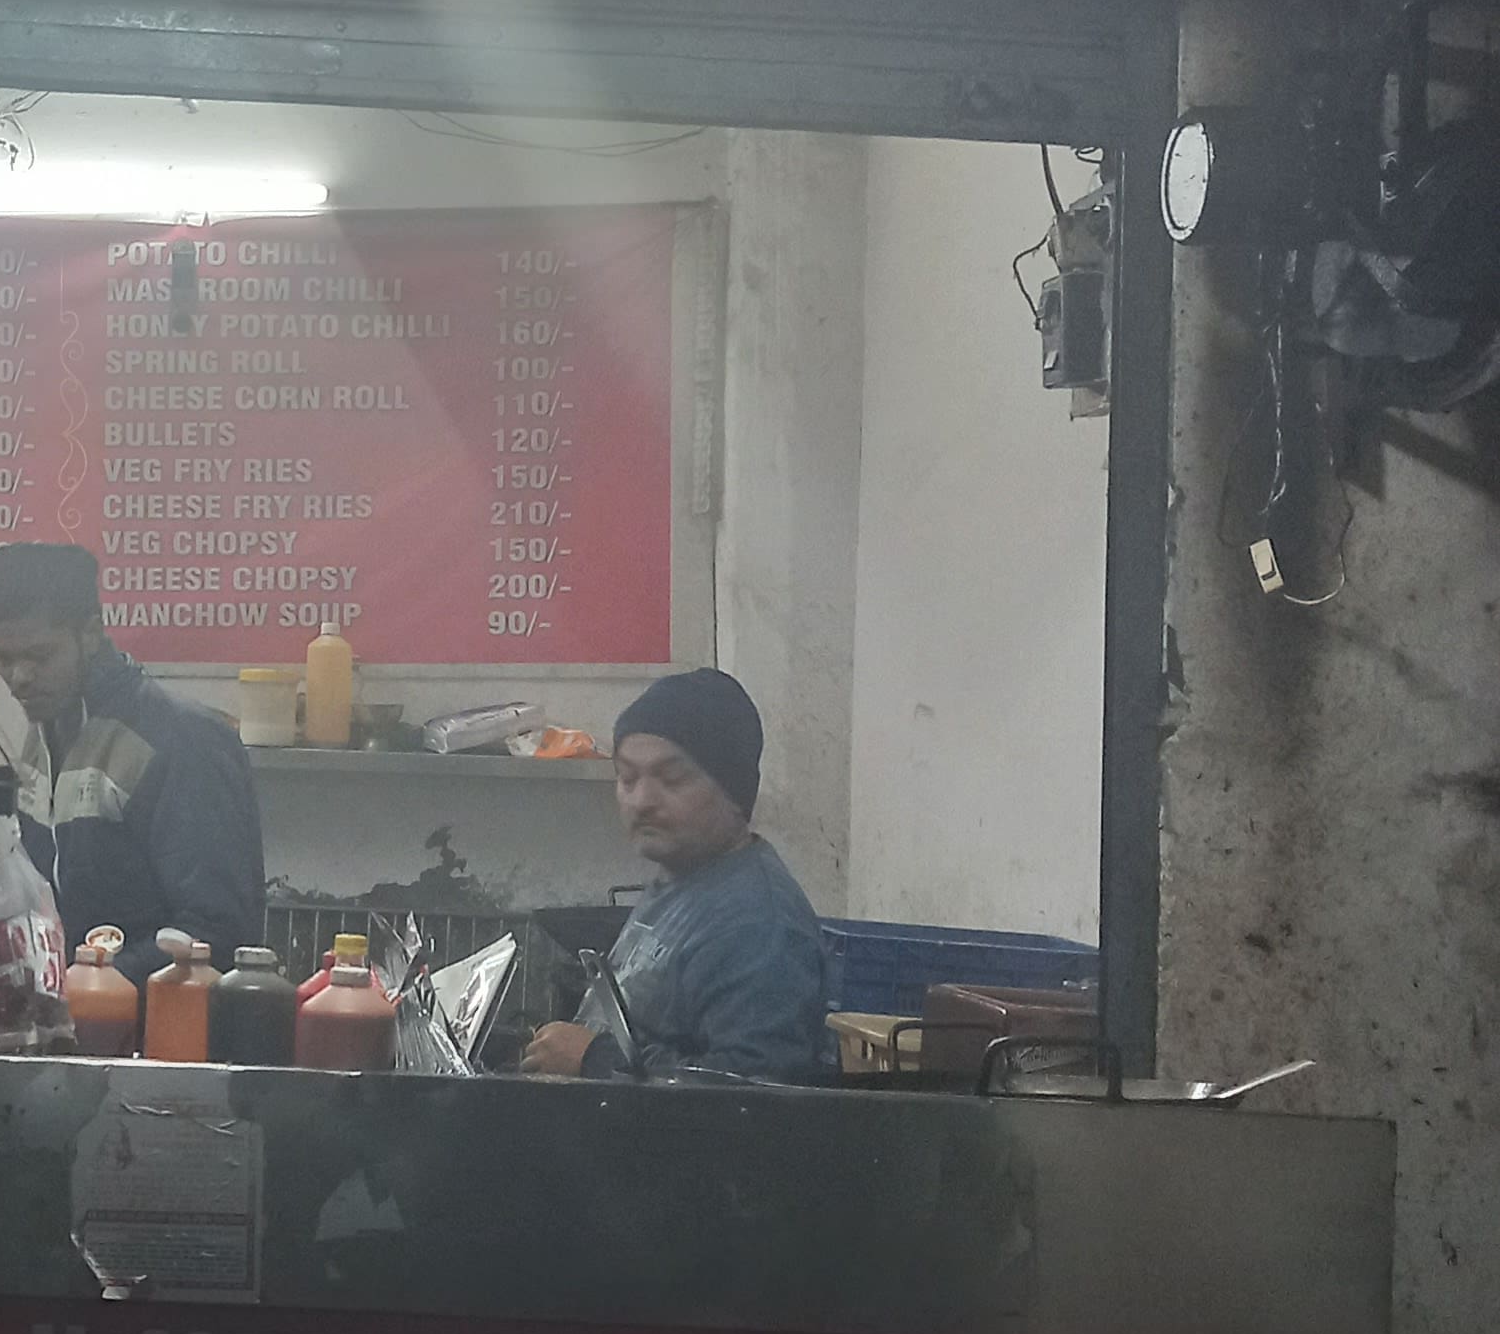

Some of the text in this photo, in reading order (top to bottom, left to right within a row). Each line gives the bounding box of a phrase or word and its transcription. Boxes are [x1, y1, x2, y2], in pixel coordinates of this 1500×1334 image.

[107, 241, 577, 276] POTTO CHILLI 140/-
[107, 276, 291, 303] MASROOM
[302, 277, 402, 304] CHILLI
[106, 313, 574, 347] HONY POTATO CHILLI 160/-
[104, 349, 574, 381] SPRING ROLL 100/-
[104, 385, 574, 417] CHEESE CORN ROLL 110/-
[103, 421, 573, 454] BULLETS 120/-
[103, 457, 572, 491] VEG FRY RIES 150/-
[103, 494, 572, 528] CHEESE FRY RIES 210/-
[102, 530, 572, 563] VEG CHOPSY 150/-
[102, 566, 572, 599] CHEESE CHOPSY 200/-
[101, 603, 551, 636] MANCHOW SOUP 90/-
